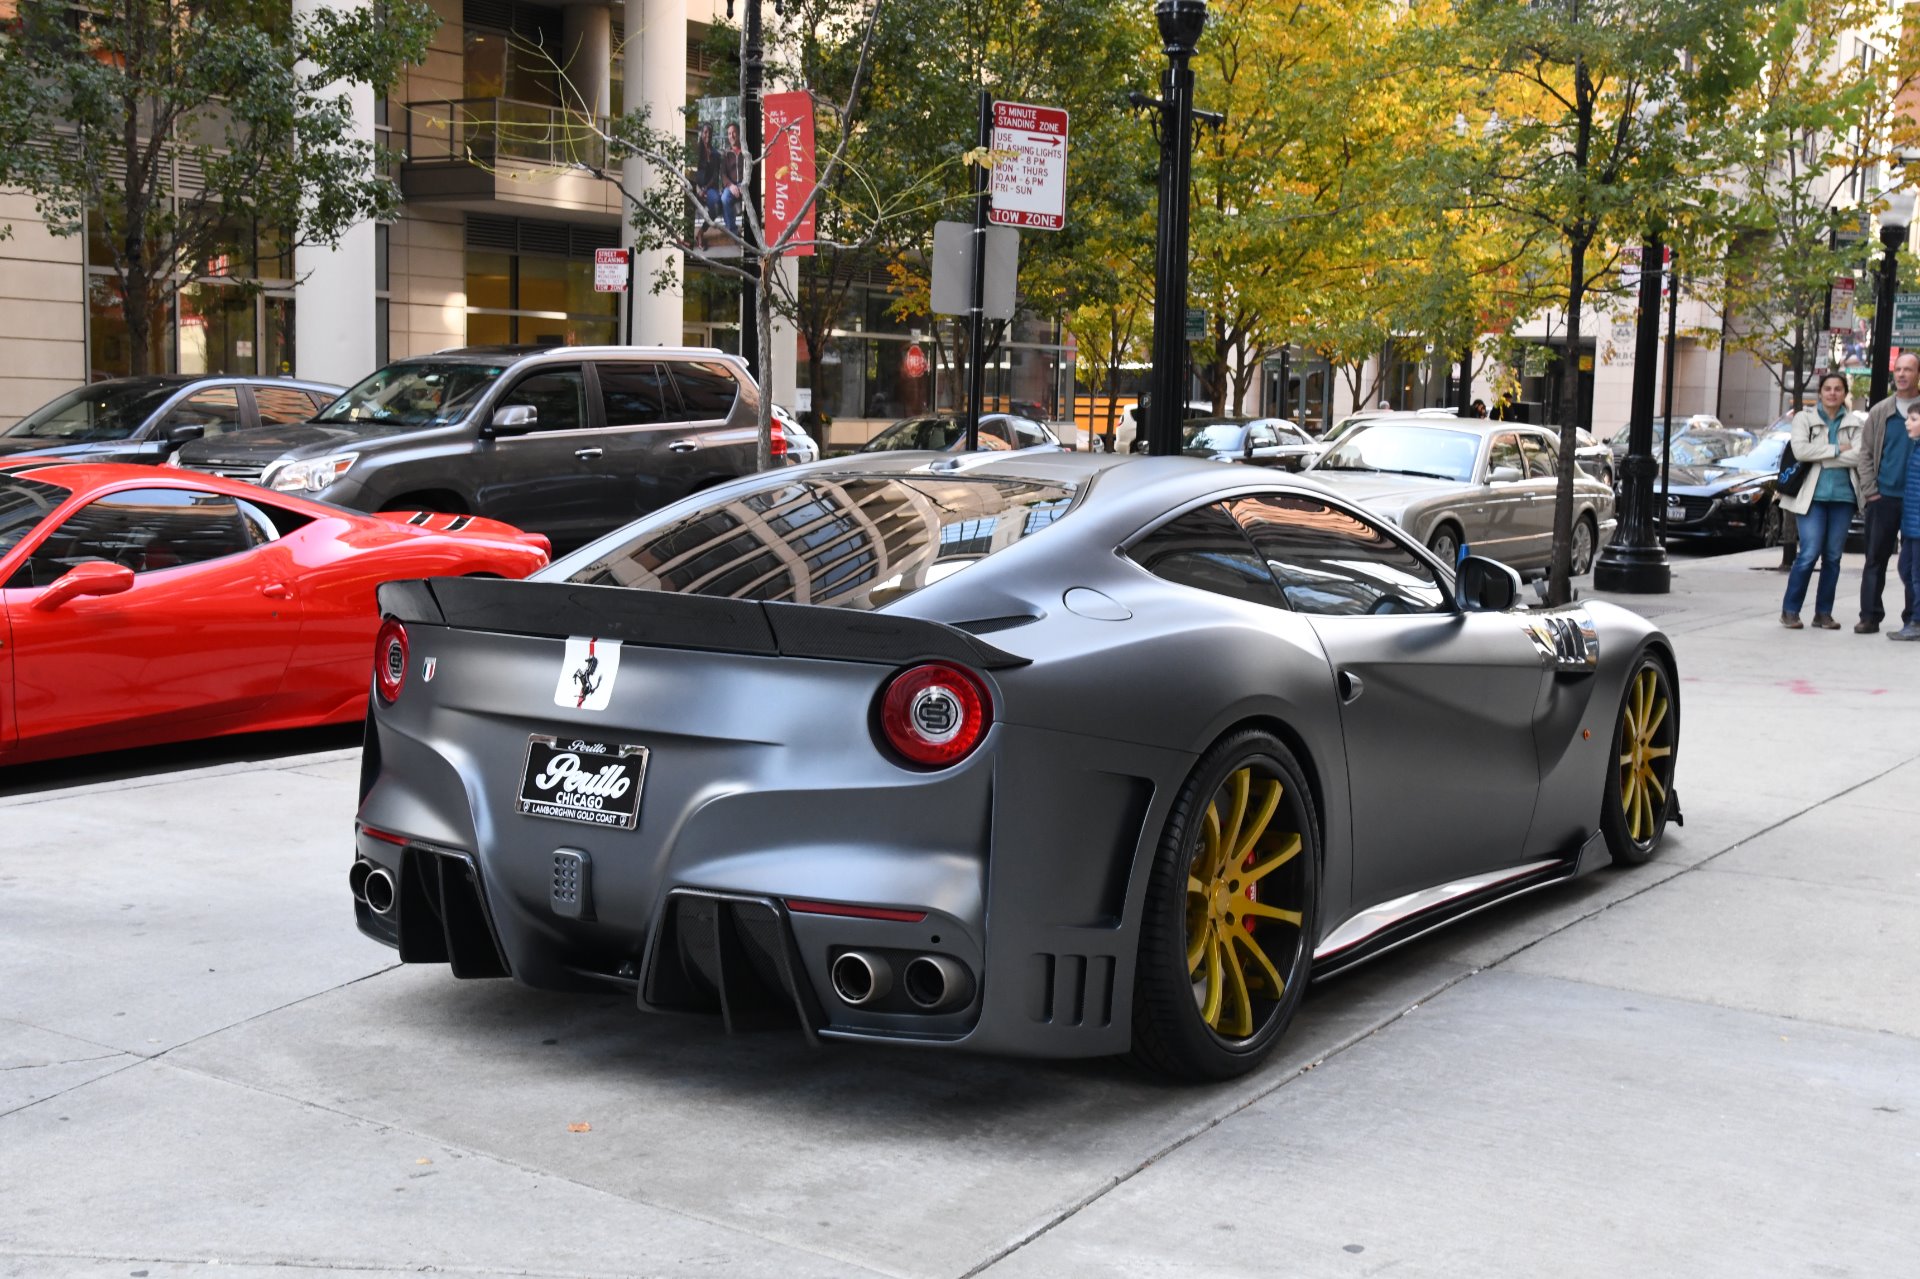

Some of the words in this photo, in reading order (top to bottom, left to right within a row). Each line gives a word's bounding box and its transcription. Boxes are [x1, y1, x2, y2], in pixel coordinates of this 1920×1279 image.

[998, 106, 1006, 115] 15
[1008, 107, 1037, 119] MINUTE
[998, 117, 1035, 129] STANDING
[1039, 122, 1060, 132] ZONE
[997, 132, 1012, 142] USE
[790, 124, 803, 183] Folded
[1026, 156, 1032, 165] 8
[1033, 157, 1046, 166] PM
[1036, 148, 1062, 159] LIGHTS
[995, 162, 1013, 173] MON
[1023, 165, 1049, 177] THURS
[995, 183, 1008, 193] FRI
[1015, 185, 1032, 195] SUN
[1025, 176, 1031, 185] 6
[1032, 177, 1044, 187] PM
[772, 183, 789, 220] Map
[994, 209, 1019, 223] TOW
[1026, 213, 1057, 227] ZONE
[568, 739, 607, 754] Perillo
[535, 753, 631, 799] Perillo
[555, 792, 604, 809] CHICAGO
[532, 804, 576, 818] LAMBORGHINI
[577, 811, 594, 822] GOLD
[595, 813, 617, 824] COAST
